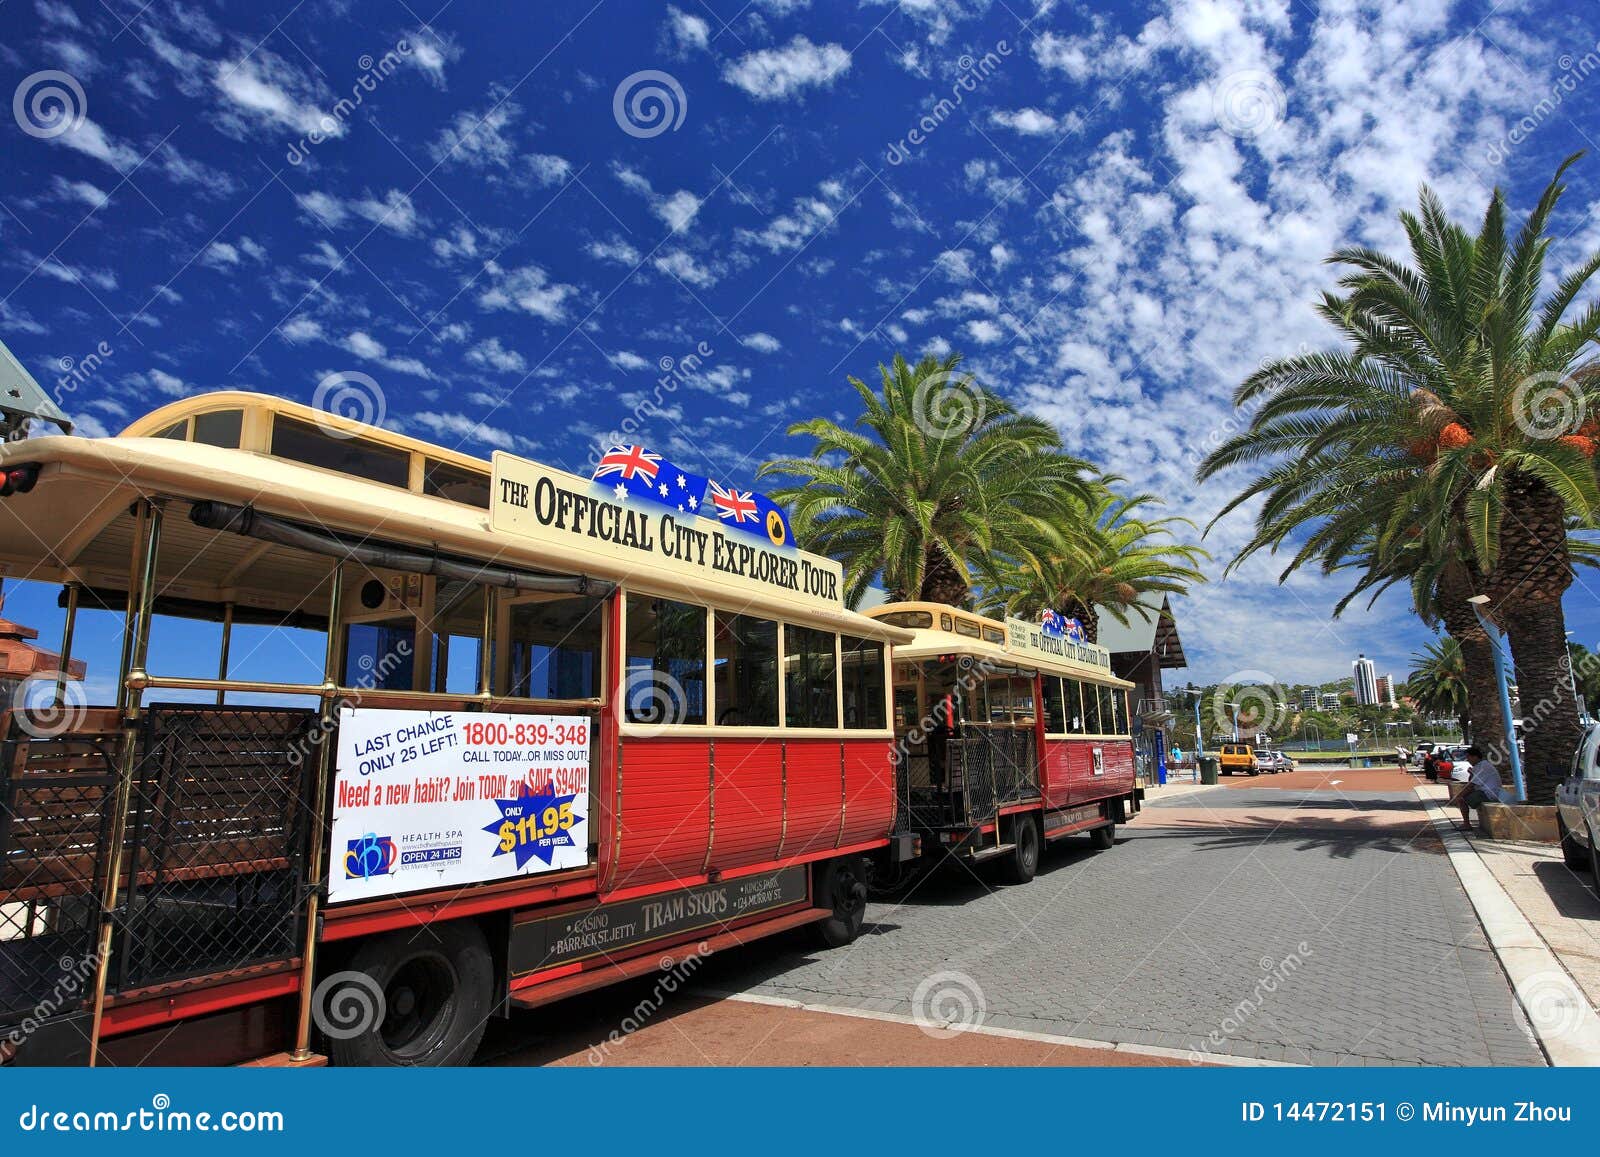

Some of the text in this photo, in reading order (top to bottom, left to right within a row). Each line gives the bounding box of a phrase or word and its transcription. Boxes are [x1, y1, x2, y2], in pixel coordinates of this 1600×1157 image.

[501, 477, 838, 601] THE OFFICIAL CITY EXPLORER TOUR
[1030, 632, 1038, 647] THE
[355, 715, 454, 757] LAST CHANCE
[463, 722, 586, 745] 1800-839-348
[360, 733, 458, 775] ONLY 25 LEFT!
[463, 751, 490, 762] CALL
[543, 751, 564, 761] MISS
[567, 750, 588, 761] OUT!
[338, 767, 587, 808] Need a new habit? Join TODAY and SAVE $940!!
[505, 806, 523, 817] ONLY
[402, 830, 462, 842] HEALTH SPA
[499, 802, 574, 852] $11.95
[539, 836, 569, 846] PER WEEK
[403, 848, 461, 862] OPEN 24 HRS
[642, 888, 727, 932] TRAM STOPS
[574, 913, 609, 933] CASINO
[557, 932, 597, 954] BARRACK
[610, 922, 637, 942] JETTY
